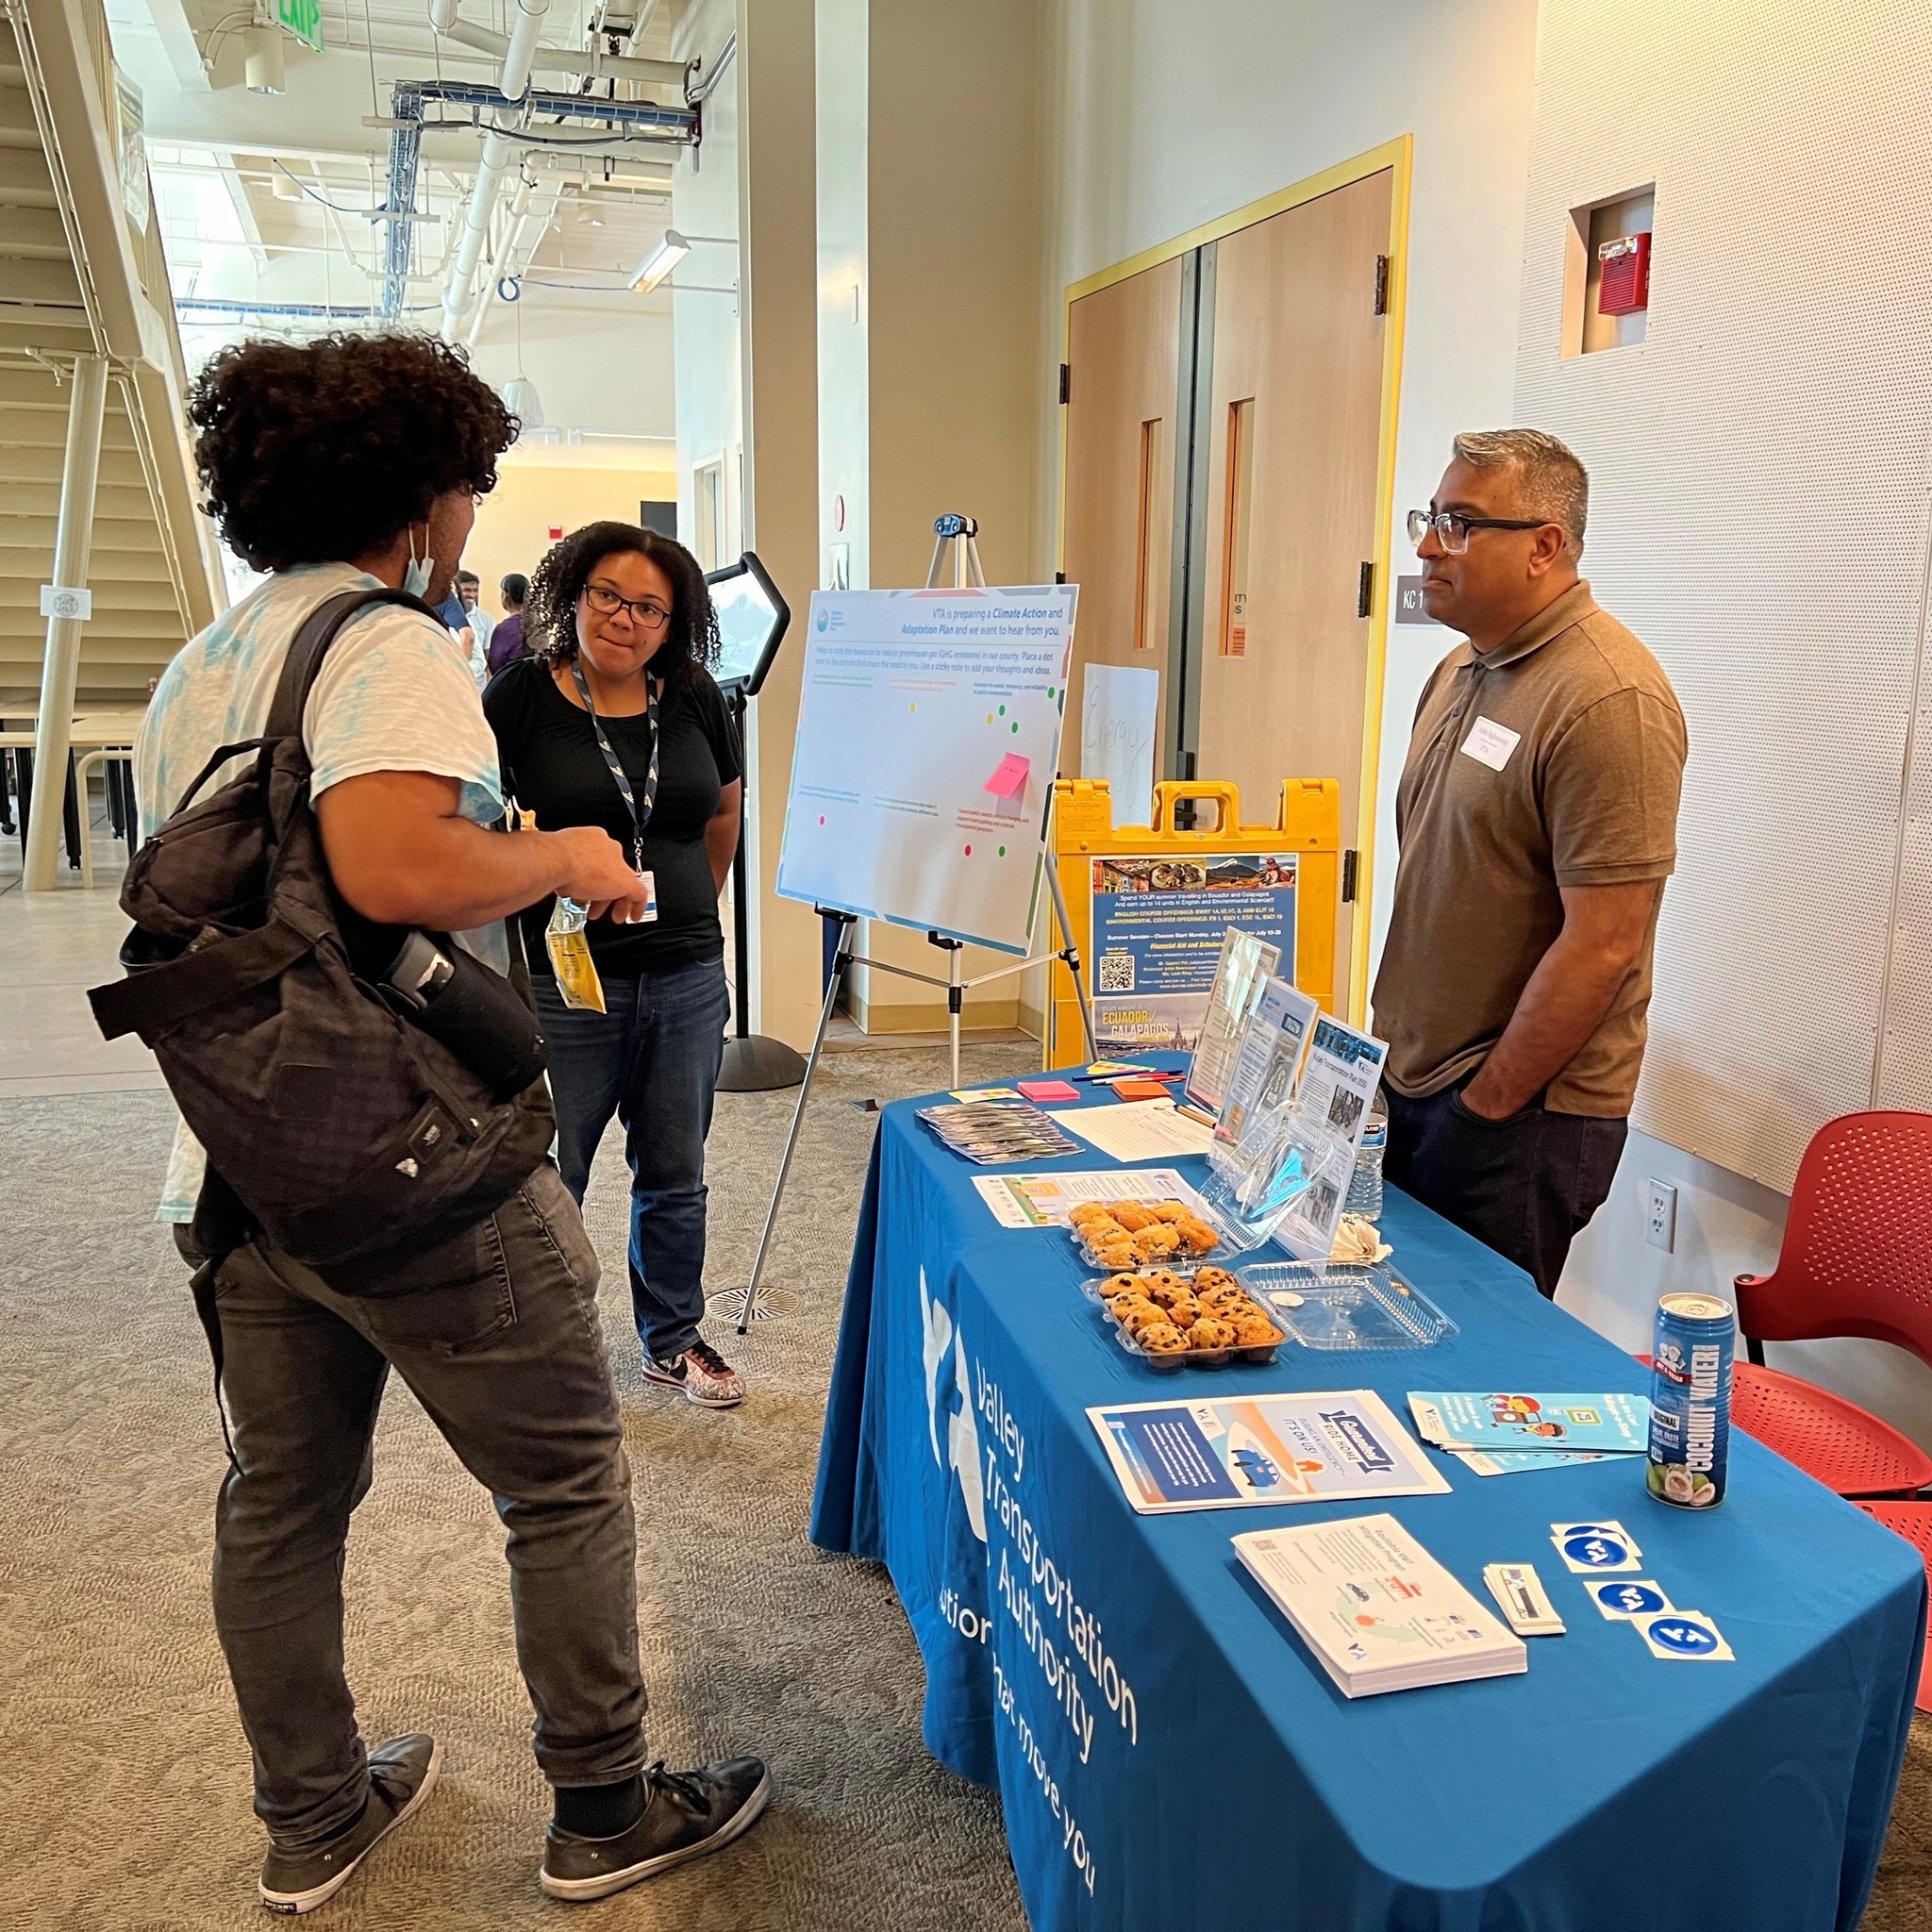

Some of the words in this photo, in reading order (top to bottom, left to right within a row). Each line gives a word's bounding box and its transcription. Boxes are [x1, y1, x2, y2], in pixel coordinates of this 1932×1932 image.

[932, 608, 945, 619] VTA
[946, 609, 952, 619] is
[953, 609, 986, 622] preparing
[987, 610, 991, 619] a
[992, 608, 1022, 619] Climate
[1022, 608, 1047, 619] Action
[1048, 607, 1063, 619] and
[1403, 590, 1416, 609] KC
[901, 624, 938, 637] Adaptation
[938, 624, 954, 635] Plan
[954, 625, 968, 635] and
[969, 626, 979, 635] we
[980, 625, 998, 635] want
[999, 625, 1007, 636] to
[1008, 625, 1024, 636] hear
[1025, 625, 1042, 636] from
[1044, 626, 1060, 639] you.
[881, 648, 898, 657] reduce
[899, 649, 927, 658] greenhouse
[928, 651, 938, 659] gas
[982, 651, 988, 659] in
[988, 652, 999, 660] our
[999, 652, 1020, 662] county.
[1021, 651, 1037, 661] Place
[1042, 652, 1054, 661] dot
[920, 662, 930, 671] Use
[935, 662, 950, 673] sticky
[951, 663, 963, 672] note
[982, 665, 995, 675] your
[995, 664, 1022, 675] thoughts
[1022, 666, 1034, 675] and
[1034, 666, 1051, 675] ideas.
[1102, 1010, 1148, 1025] ECUADOR
[1111, 1023, 1170, 1038] GALAPAGOS
[1690, 1351, 1720, 1401] WATER
[975, 1357, 1024, 1482] Valley
[1293, 1431, 1308, 1441] ON
[1298, 1418, 1316, 1436] DURING
[1323, 1424, 1341, 1440] RIDE
[1340, 1440, 1359, 1461] HOME
[1340, 1421, 1386, 1461] Guaranteed
[1686, 1405, 1716, 1472] COCONUT
[1358, 1525, 1385, 1550] Mitigation
[1381, 1550, 1406, 1571] Program
[1374, 1529, 1400, 1553] Equitable
[1398, 1553, 1414, 1564] VMT
[986, 1444, 1137, 1746] Transportation
[998, 1547, 1094, 1764] Authority
[992, 1651, 1016, 1726] hat
[1019, 1712, 1061, 1820] move
[1063, 1805, 1095, 1898] you
